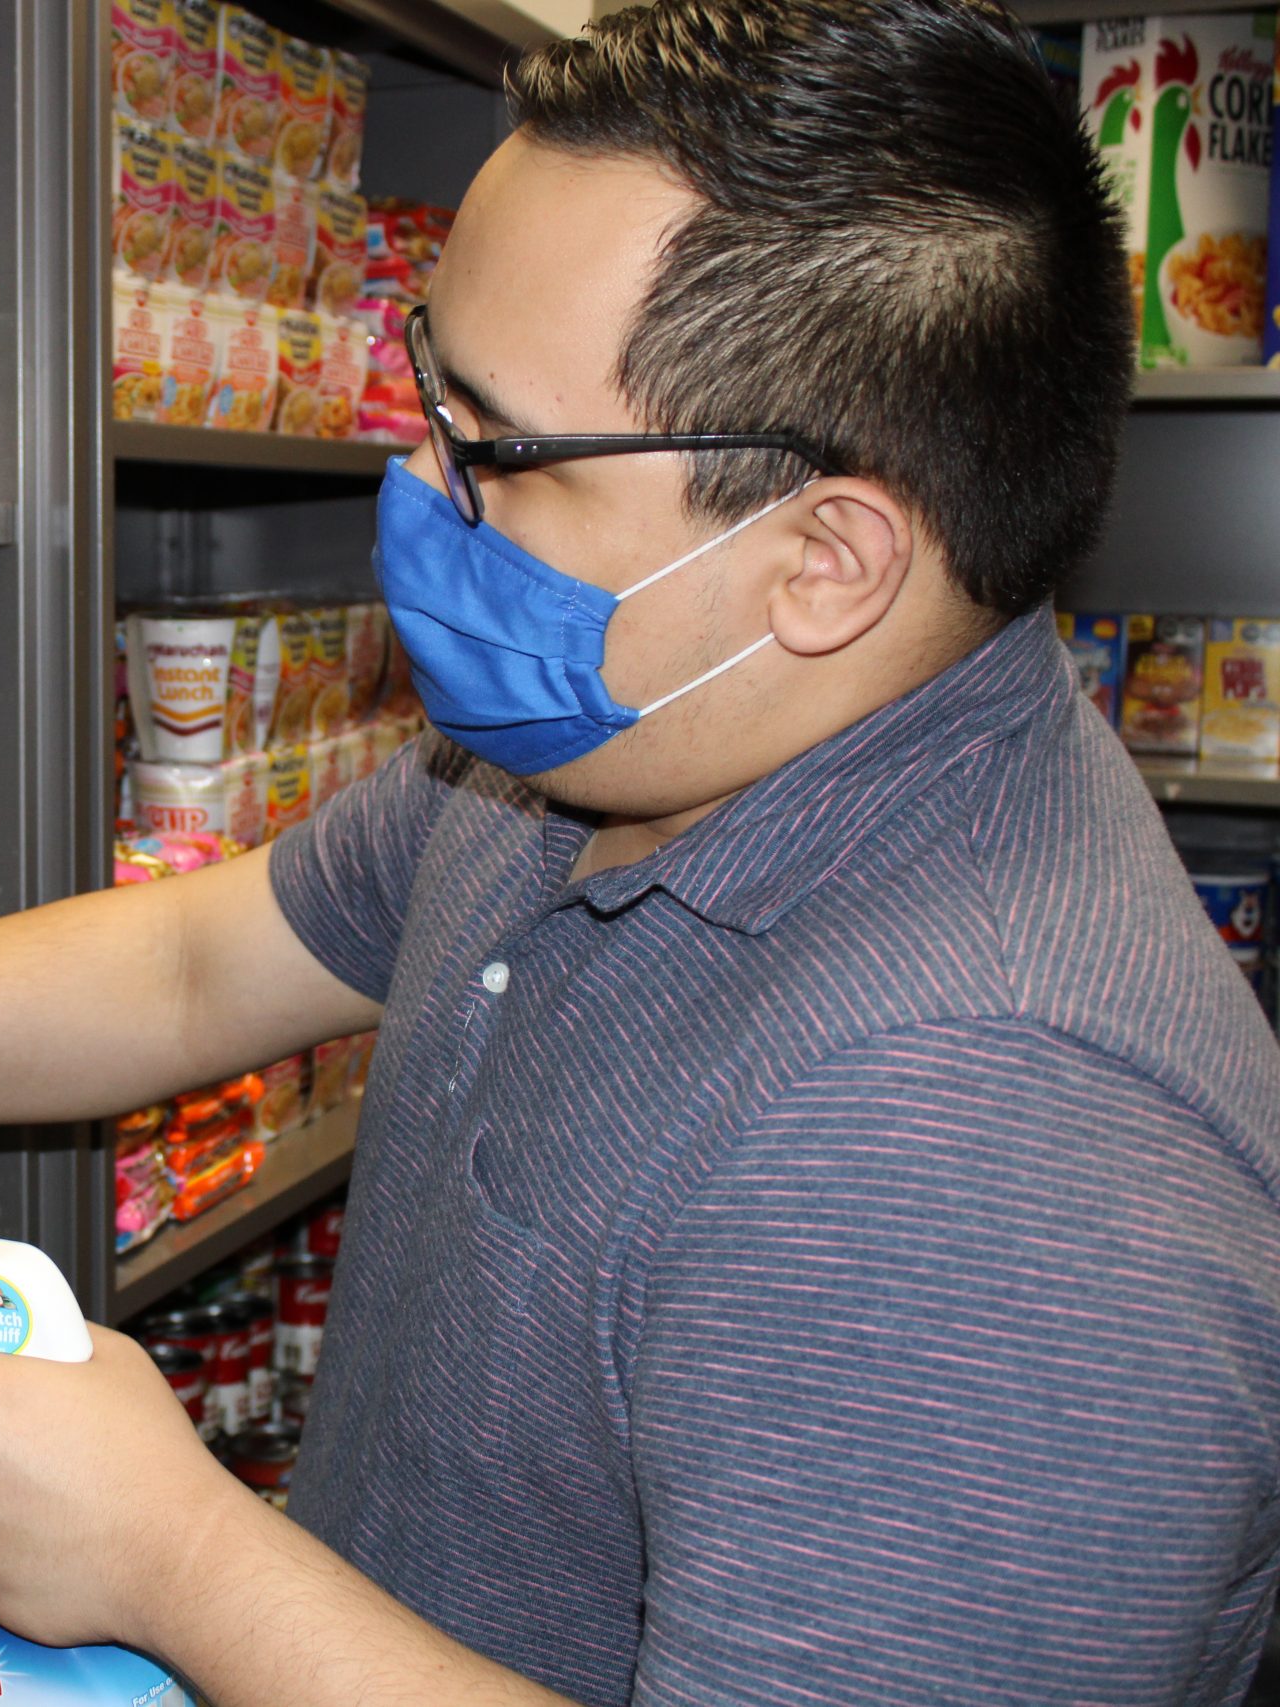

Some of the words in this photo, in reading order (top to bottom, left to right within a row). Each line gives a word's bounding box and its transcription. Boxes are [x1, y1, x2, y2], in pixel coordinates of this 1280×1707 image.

[153, 667, 220, 683] Instant
[157, 684, 214, 702] Lunch
[132, 1693, 148, 1707] For
[149, 1682, 165, 1698] Use
